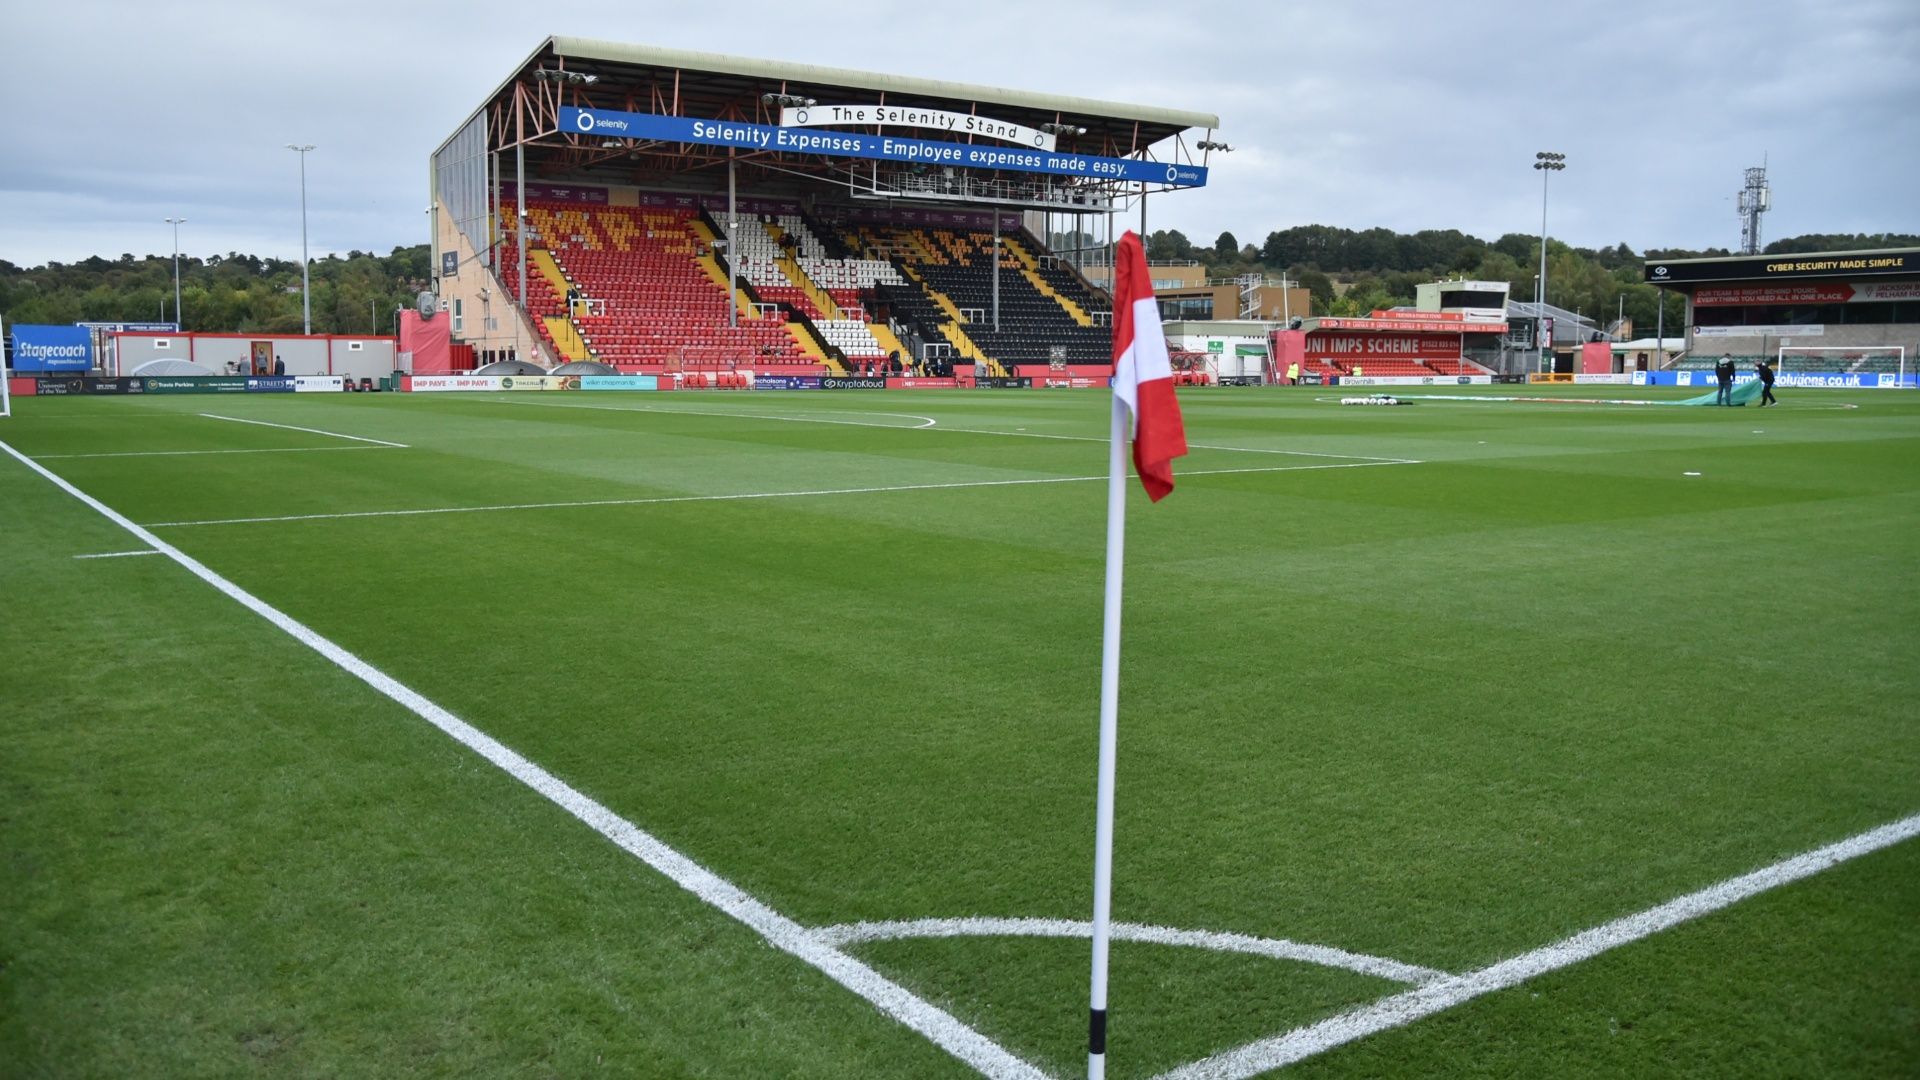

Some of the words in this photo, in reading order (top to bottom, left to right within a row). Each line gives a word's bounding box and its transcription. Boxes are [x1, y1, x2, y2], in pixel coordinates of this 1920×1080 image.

[596, 119, 629, 131] selenity
[832, 107, 865, 121] The
[876, 108, 955, 129] Selenity
[965, 117, 1017, 139] Stand
[693, 121, 771, 147] Selenity
[777, 130, 861, 151] Expenses
[883, 141, 962, 161] Employee
[970, 150, 1041, 168] expenses
[1048, 157, 1086, 171] made
[1093, 162, 1127, 178] easy.
[1178, 171, 1198, 182] selenity
[1767, 263, 1794, 272] CYBER
[1795, 261, 1838, 271] SECURITY
[1840, 260, 1867, 269] MADE
[1868, 258, 1903, 267] SIMPLE
[1876, 290, 1908, 298] PELHAM
[20, 342, 86, 361] Stagecoach
[1331, 338, 1362, 353] IMPS
[1367, 338, 1419, 353] SCHEME
[836, 379, 884, 389] KryptoKloud
[1345, 377, 1375, 385] Brownhills
